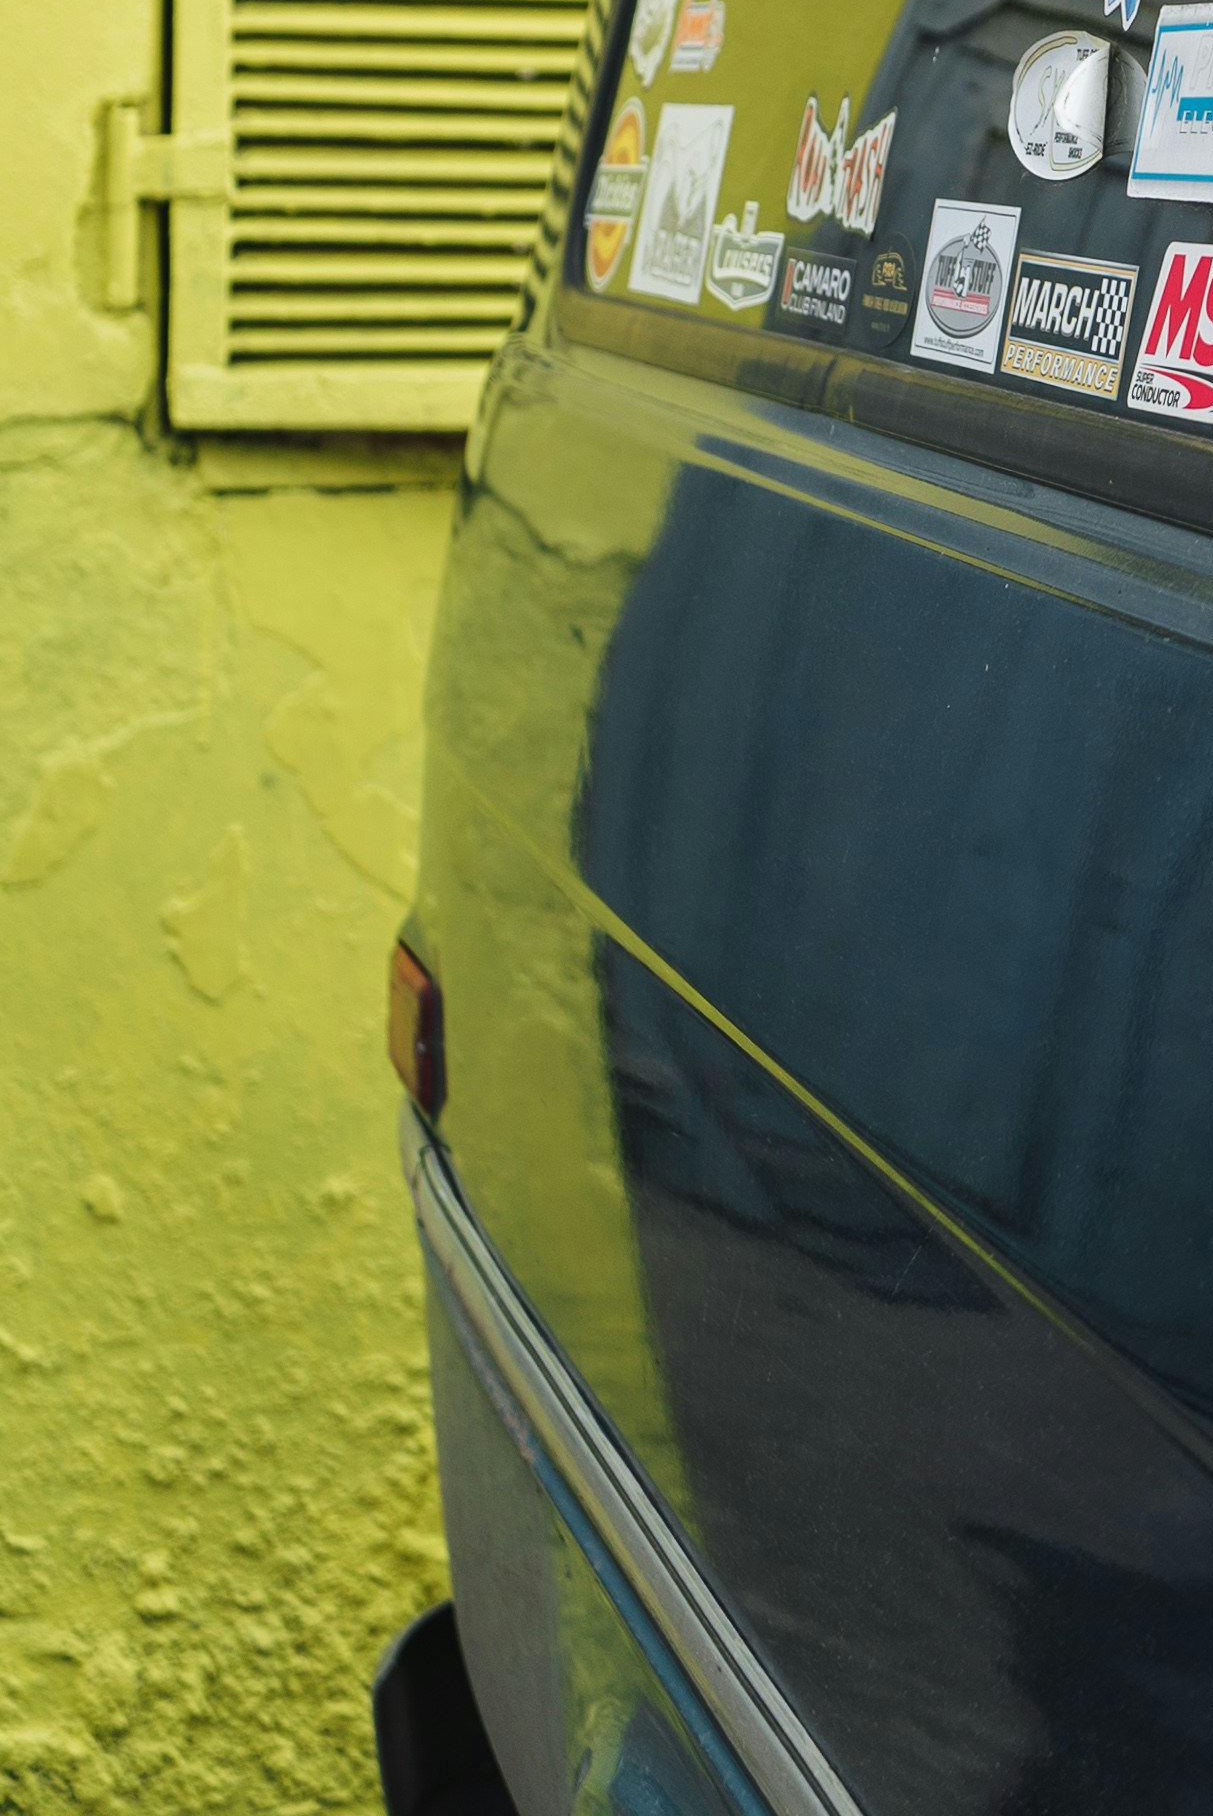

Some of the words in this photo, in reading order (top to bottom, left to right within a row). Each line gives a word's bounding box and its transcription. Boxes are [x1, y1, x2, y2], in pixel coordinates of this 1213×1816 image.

[793, 260, 851, 302] CAMARO
[935, 254, 958, 289] TUFF
[969, 259, 997, 296] STUFF
[810, 298, 847, 325] FINLAND
[1011, 276, 1100, 342] MARCH
[1002, 343, 1119, 393] PERFORMANCE
[1135, 370, 1155, 384] SUPER
[1130, 383, 1181, 409] CONDUCTOR
